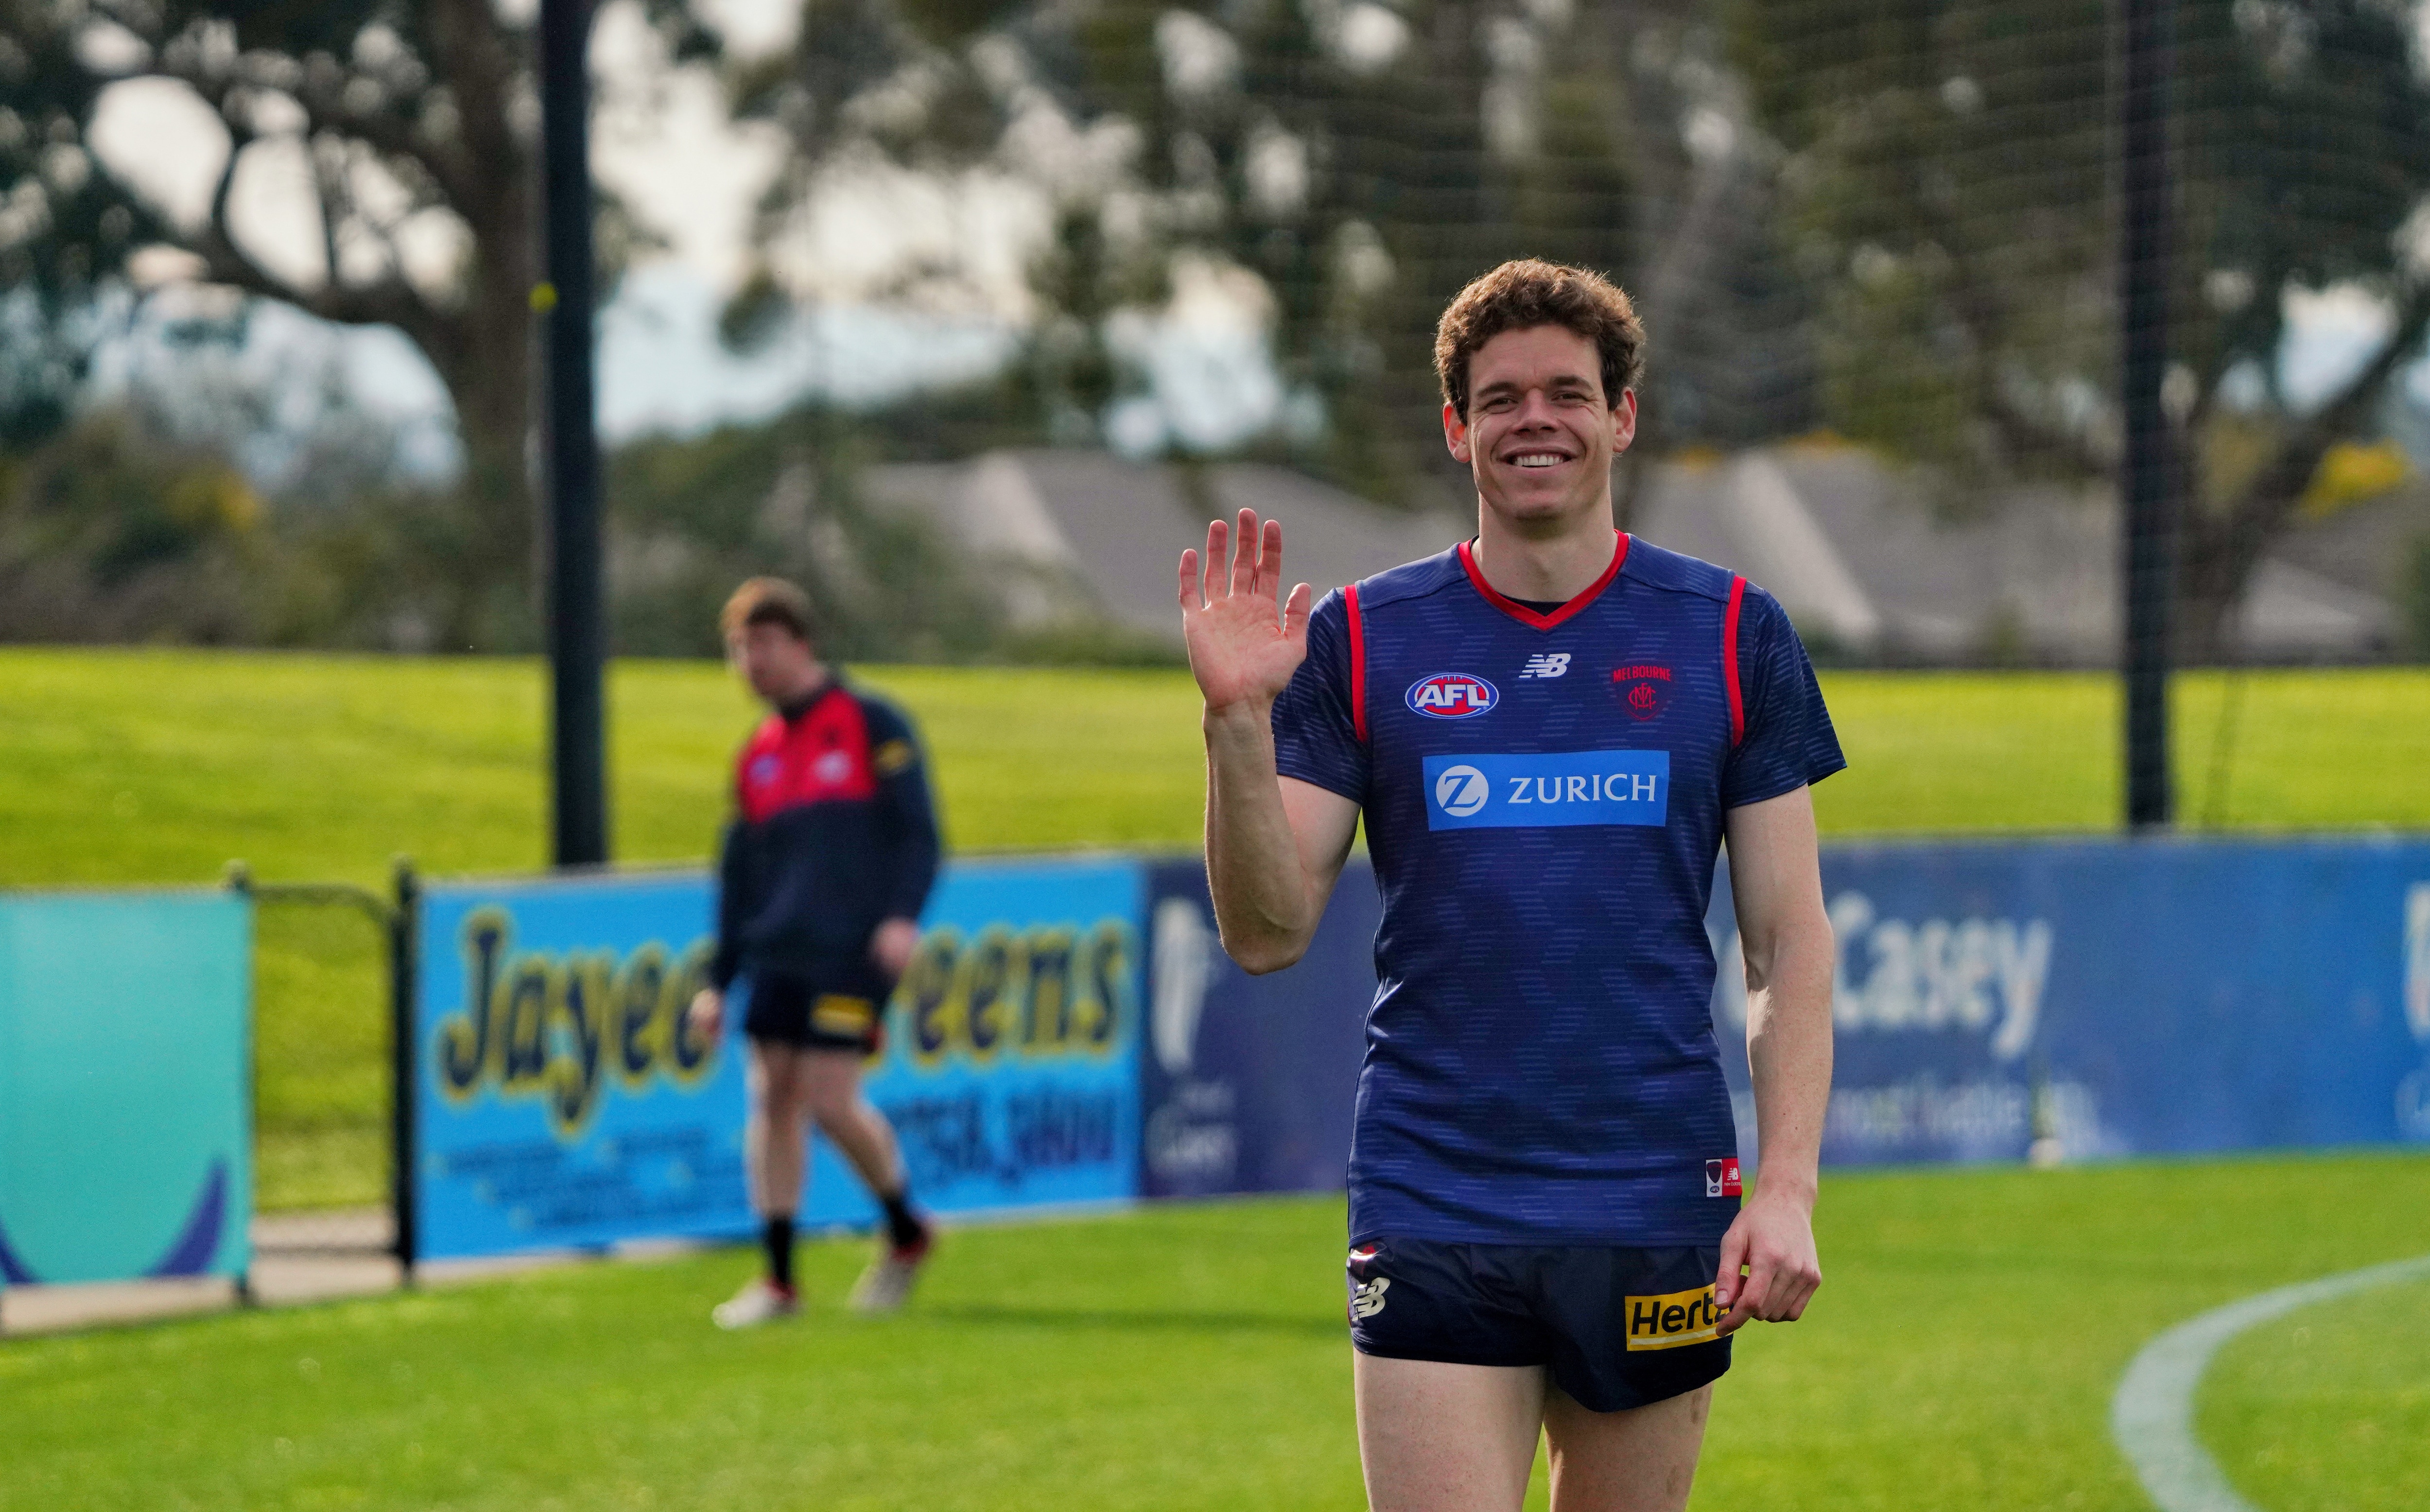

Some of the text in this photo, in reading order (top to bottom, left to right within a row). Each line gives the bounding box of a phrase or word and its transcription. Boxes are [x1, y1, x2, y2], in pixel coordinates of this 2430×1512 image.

[1613, 665, 1671, 682] MELBOURNE
[1414, 684, 1490, 708] AFL
[1508, 773, 1657, 803] ZURICH
[1829, 890, 2053, 1060] Casey
[897, 918, 1128, 1067] eens
